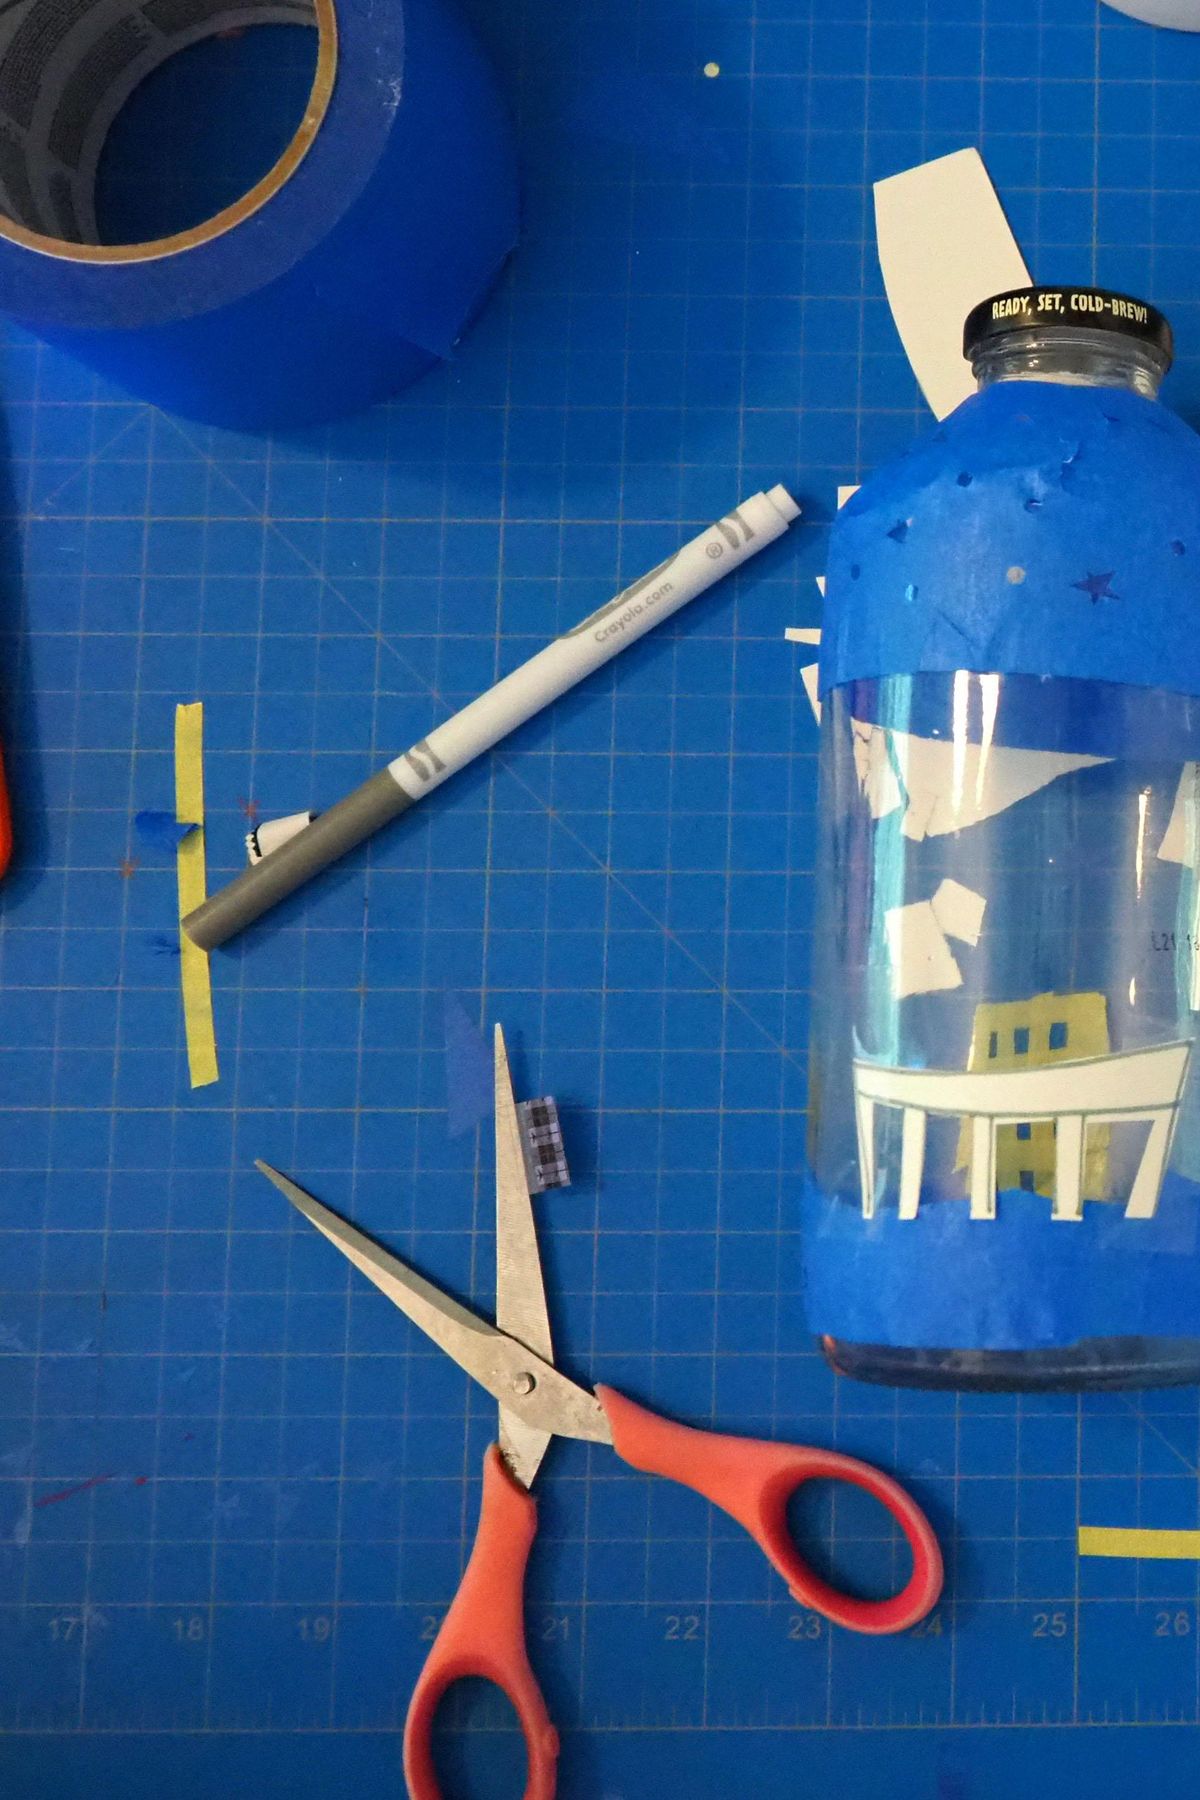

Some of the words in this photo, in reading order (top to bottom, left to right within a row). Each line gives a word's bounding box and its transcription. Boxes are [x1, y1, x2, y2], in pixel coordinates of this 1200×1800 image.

[992, 295, 1032, 320] READY,
[1037, 293, 1065, 314] SET,
[1070, 293, 1148, 324] COLD-BREW!
[593, 581, 674, 643] Crayola.com
[48, 1615, 81, 1642] 17
[173, 1616, 204, 1641] 18
[298, 1616, 331, 1642] 19
[419, 1615, 443, 1640] 2
[541, 1615, 571, 1641] 21
[664, 1615, 700, 1641] 22
[787, 1615, 821, 1641] 23
[1032, 1612, 1067, 1638] 25
[1154, 1610, 1191, 1637] 26
